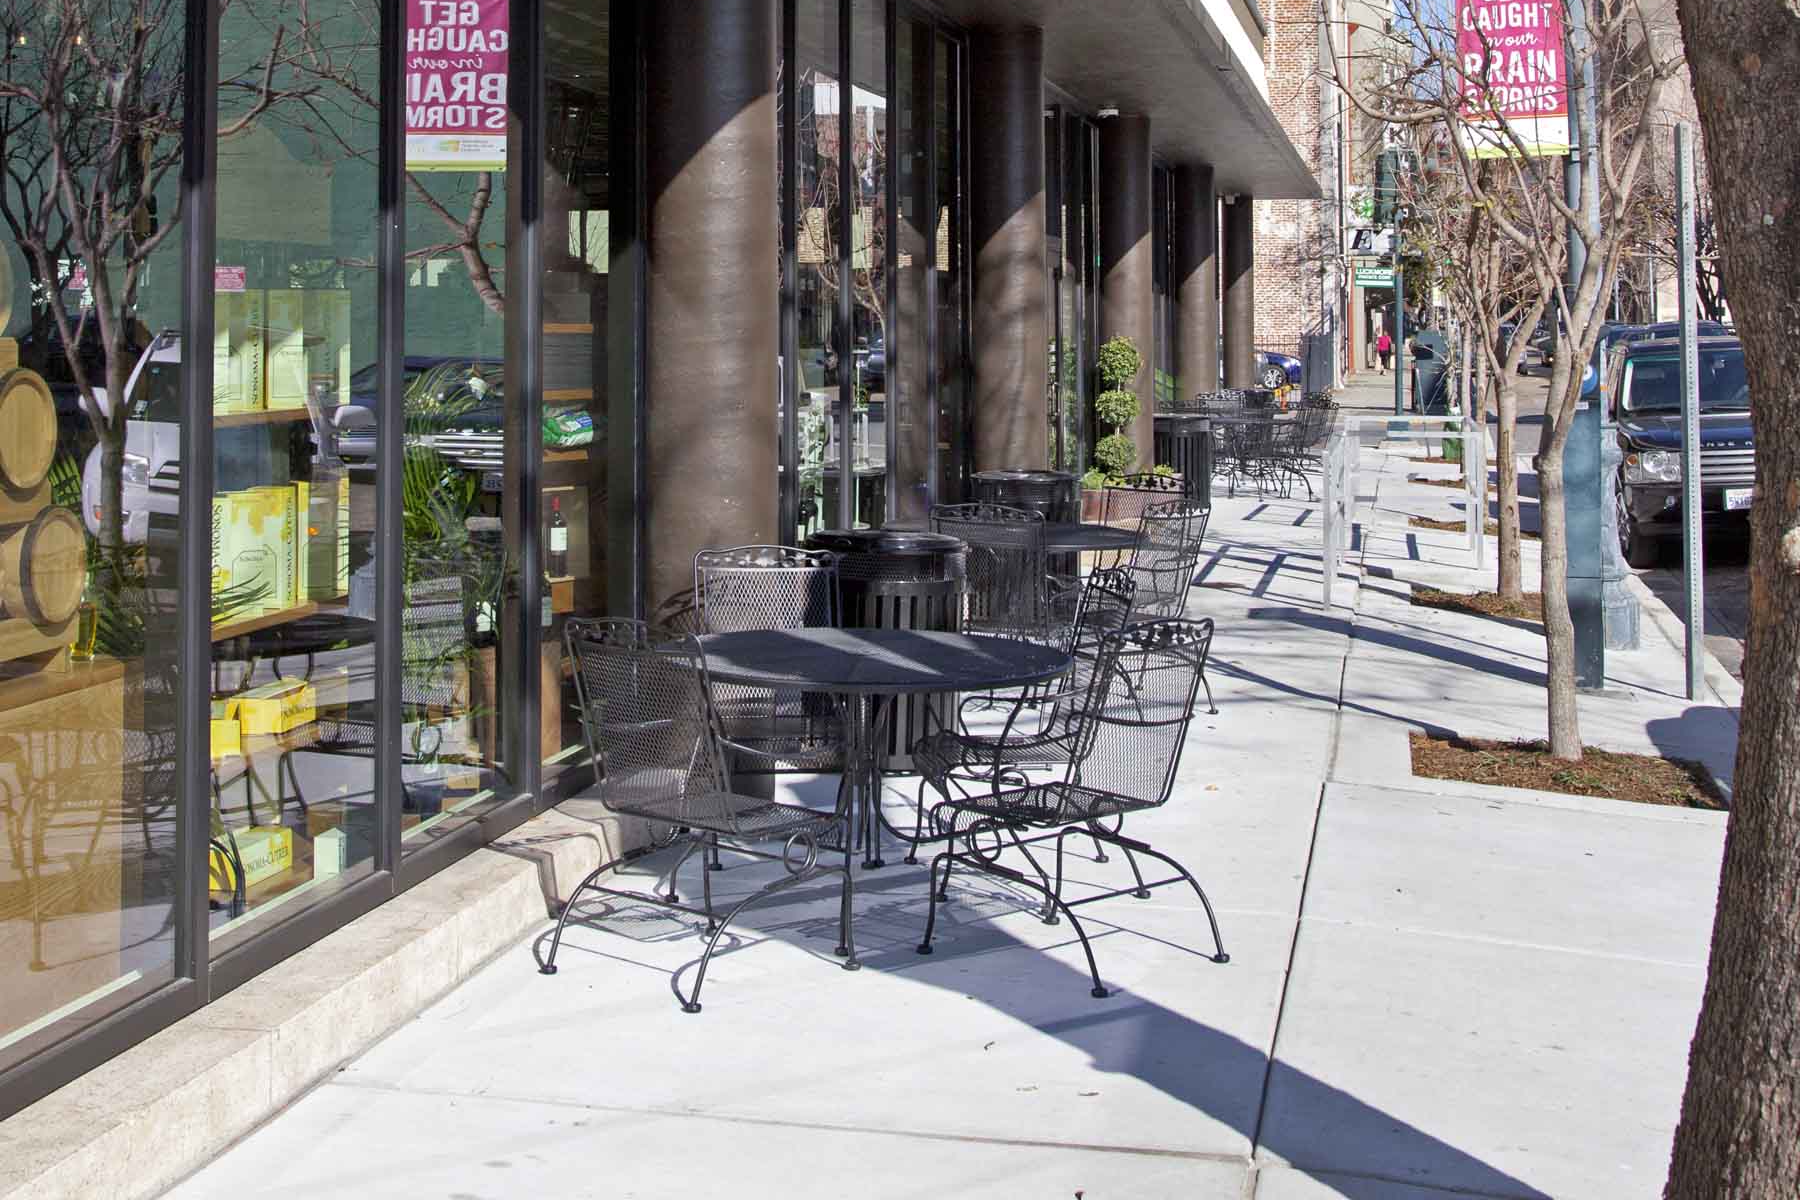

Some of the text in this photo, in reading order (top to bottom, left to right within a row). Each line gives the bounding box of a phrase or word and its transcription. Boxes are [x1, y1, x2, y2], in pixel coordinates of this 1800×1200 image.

[1462, 2, 1552, 32] CAUGHT
[1505, 32, 1538, 47] our
[1464, 49, 1557, 85] BRAIN
